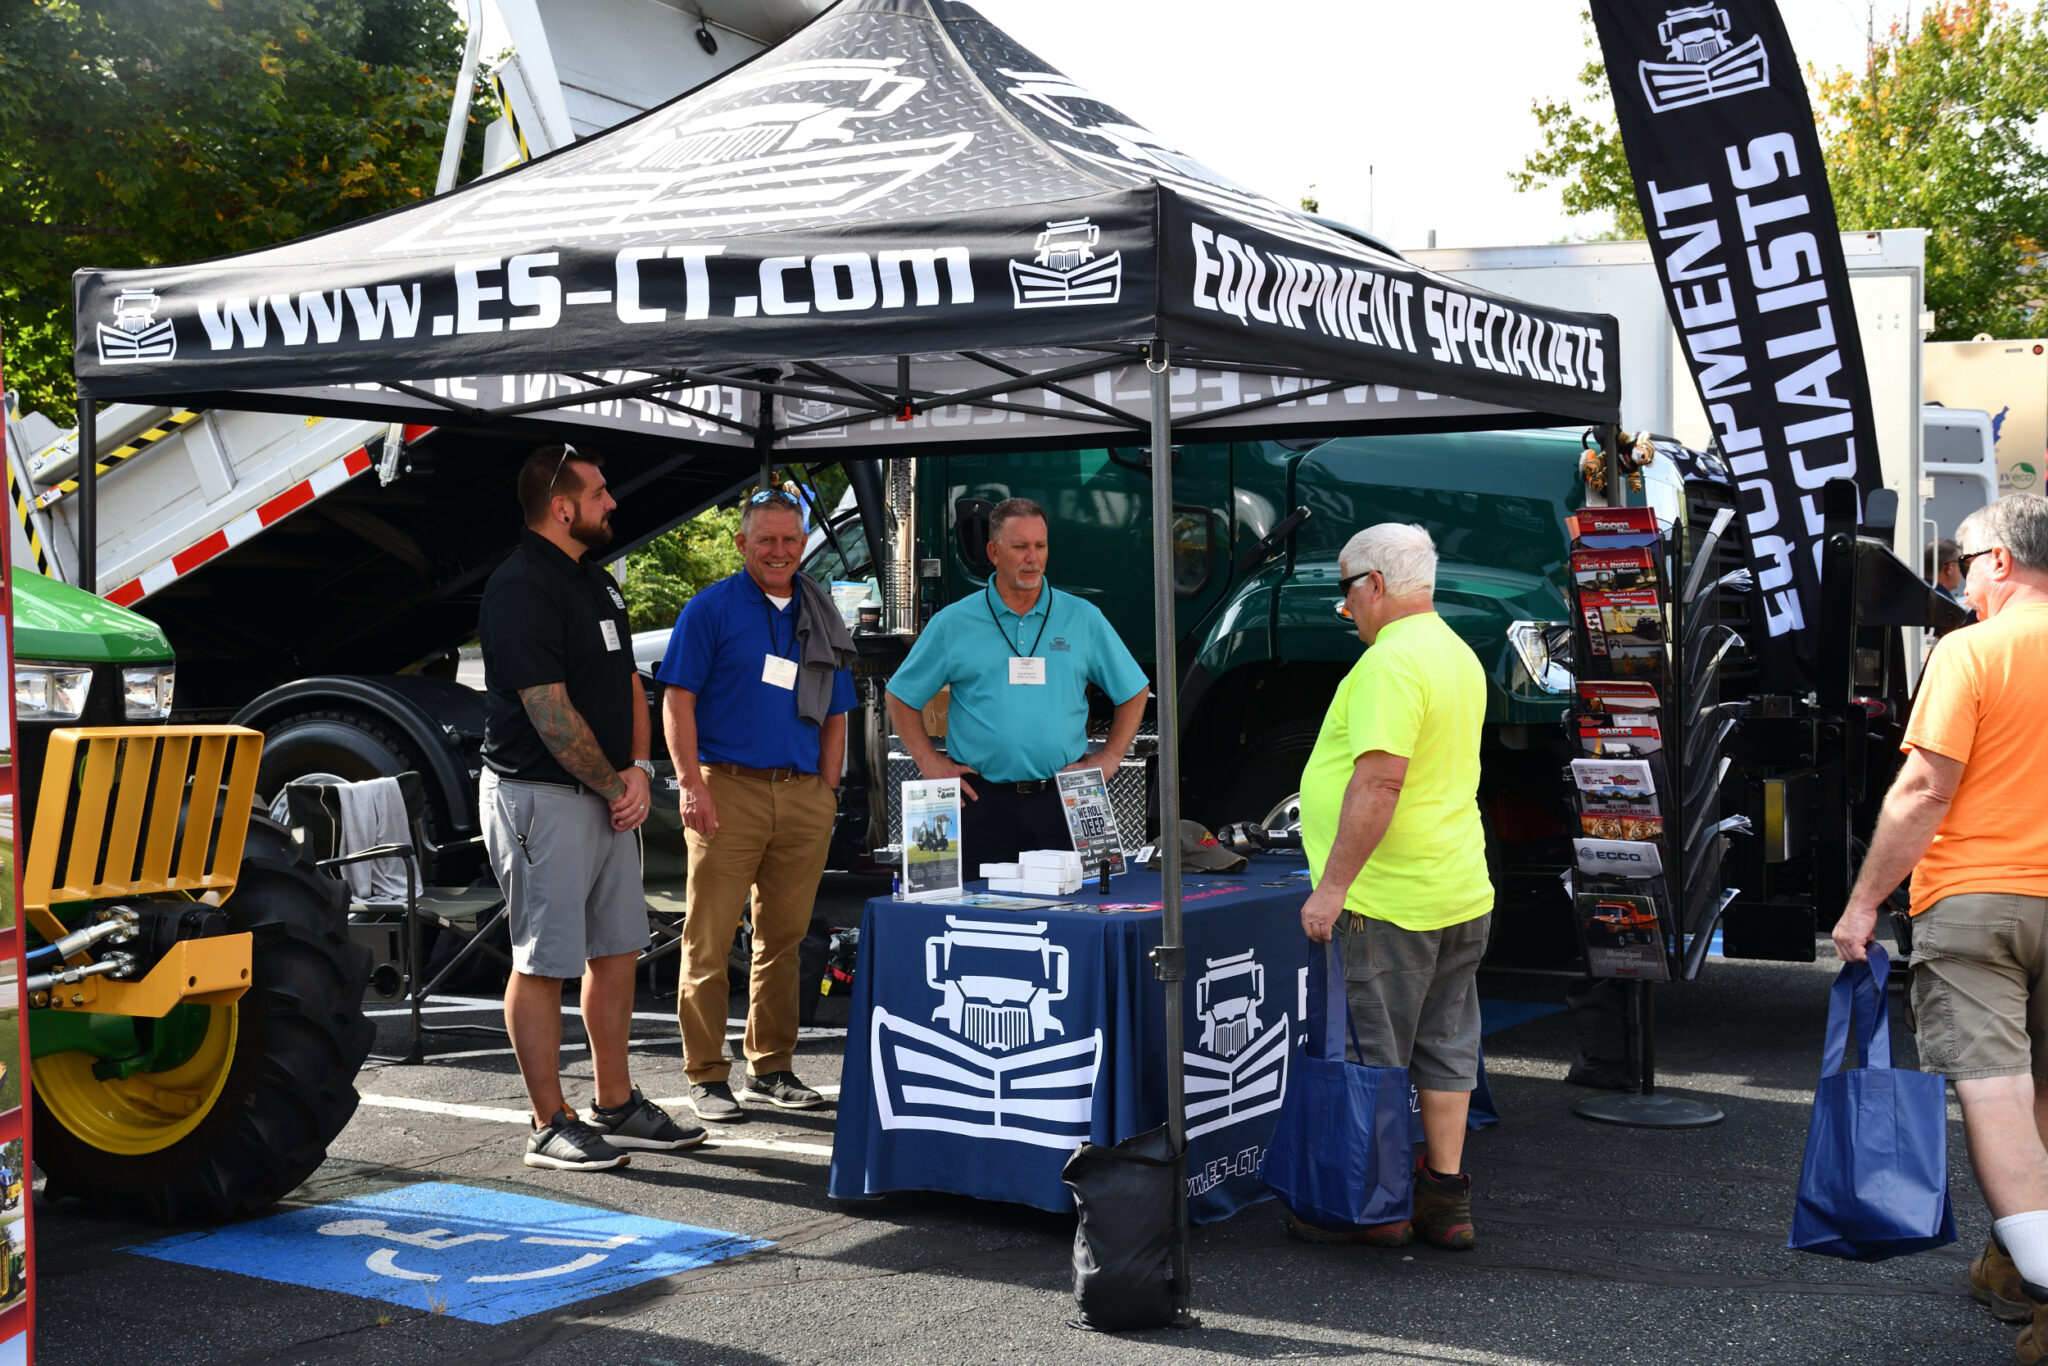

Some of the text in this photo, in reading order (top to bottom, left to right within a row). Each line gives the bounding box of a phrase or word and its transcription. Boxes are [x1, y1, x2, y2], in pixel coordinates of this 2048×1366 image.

[1191, 222, 1606, 393] EQUIPMENT SPECIALISTS
[1648, 180, 1805, 637] EQUIPMENT
[1594, 522, 1630, 531] Boom
[1609, 562, 1639, 570] Rotary
[1598, 728, 1633, 736] PARTS
[1076, 804, 1103, 819] WE ROLL
[1080, 817, 1105, 838] DEEP
[1596, 851, 1642, 862] ECCO
